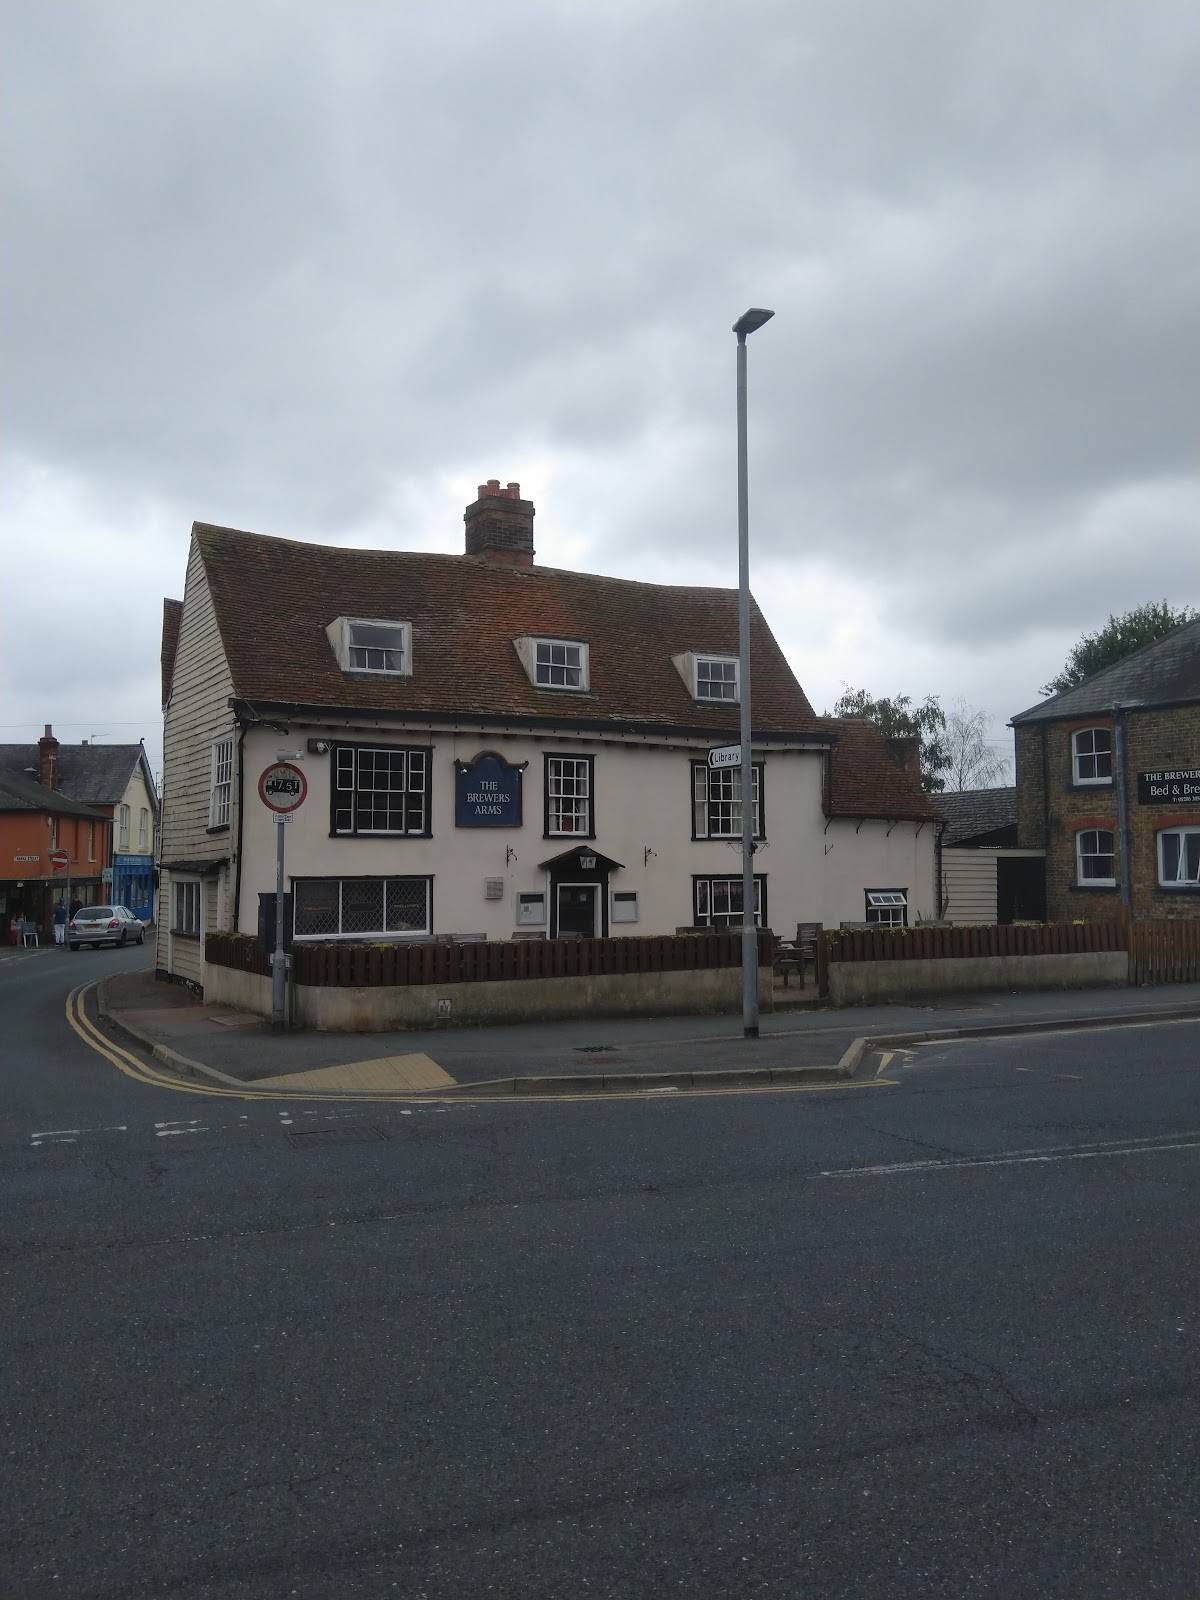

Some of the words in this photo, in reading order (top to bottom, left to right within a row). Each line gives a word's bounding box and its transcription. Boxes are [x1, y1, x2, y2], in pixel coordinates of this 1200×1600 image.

[715, 752, 739, 762] Library
[1144, 772, 1162, 781] THE
[480, 781, 497, 790] THE
[1151, 784, 1168, 796] Bed
[1172, 785, 1180, 795] &
[466, 793, 510, 802] BREWERS
[474, 805, 502, 814] ARMS
